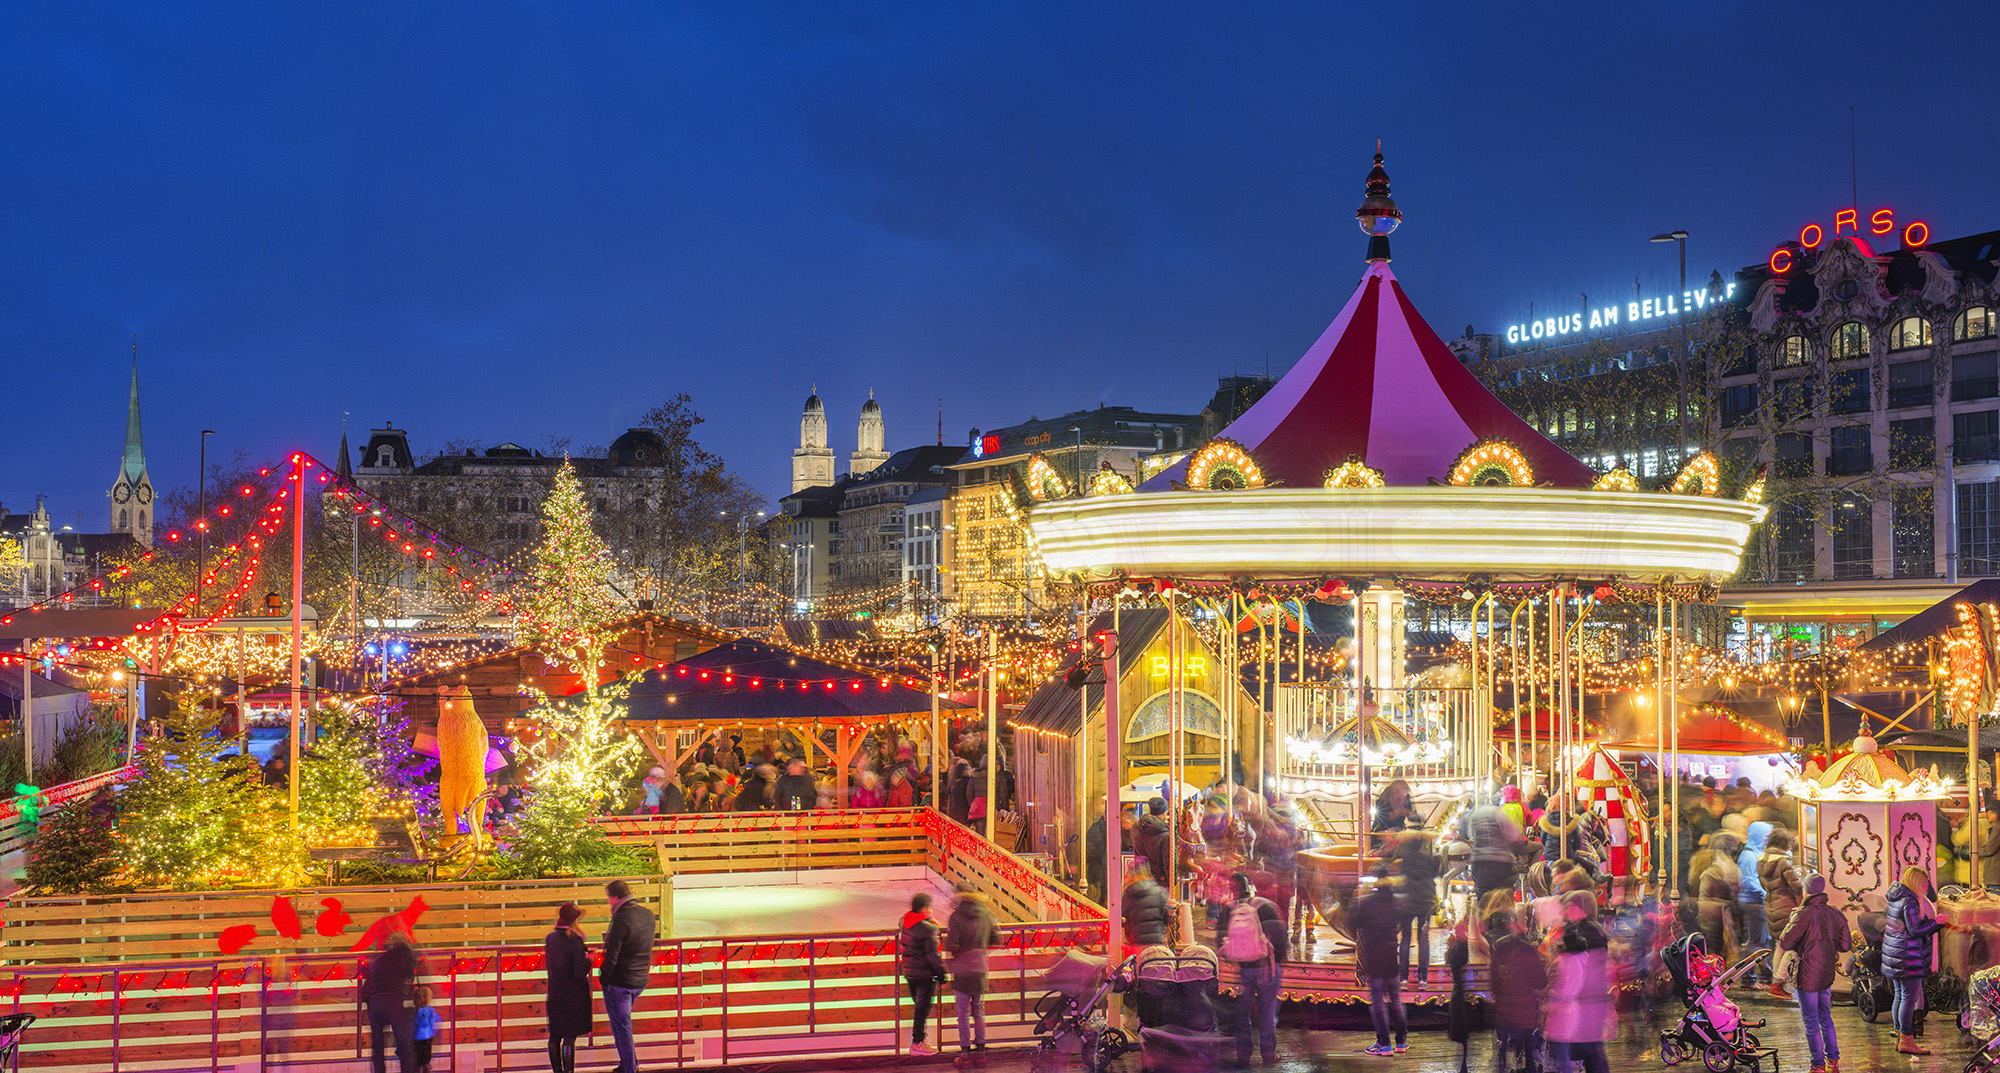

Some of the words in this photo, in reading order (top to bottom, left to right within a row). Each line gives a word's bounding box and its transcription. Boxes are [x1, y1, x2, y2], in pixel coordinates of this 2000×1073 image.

[1771, 208, 1929, 273] CORSO
[1507, 312, 1583, 344] GLOBUS
[1589, 305, 1619, 329] AM
[1628, 282, 1737, 322] BELLEV
[982, 435, 1000, 454] UBS
[1024, 435, 1040, 447] coop
[1040, 431, 1052, 444] city
[1150, 656, 1209, 677] BAR
